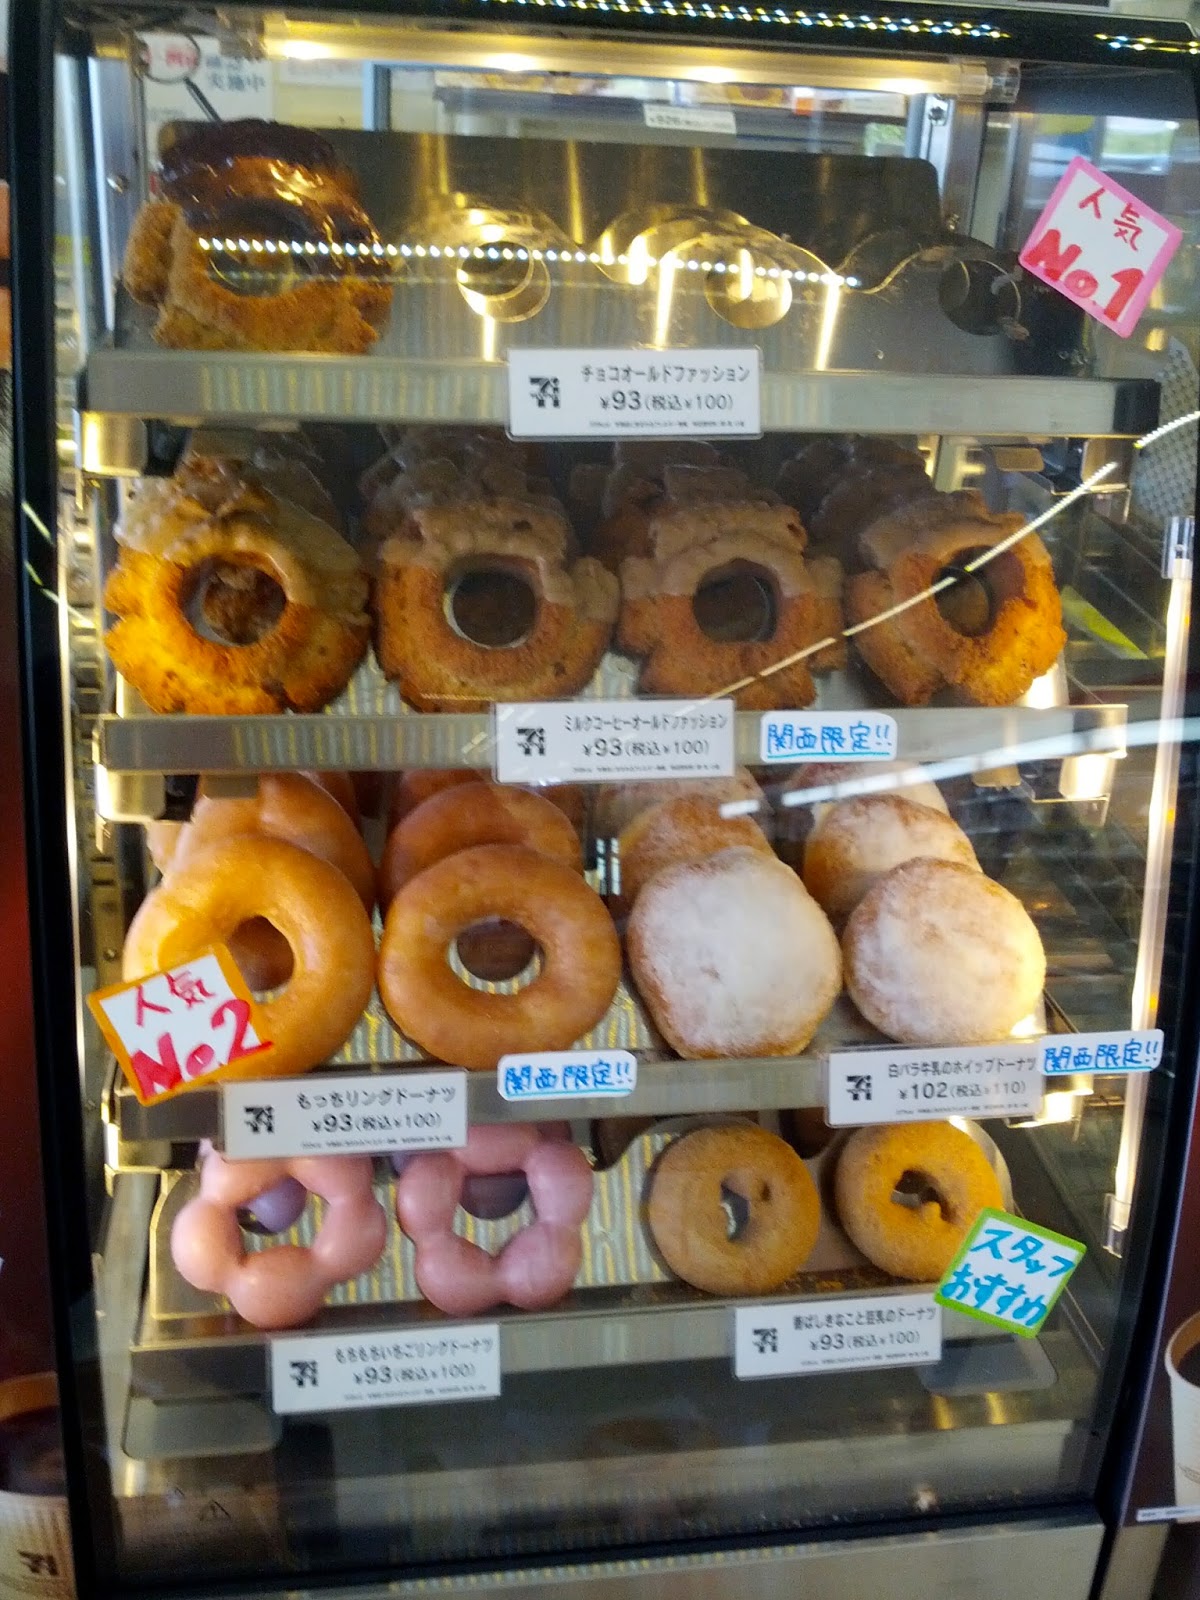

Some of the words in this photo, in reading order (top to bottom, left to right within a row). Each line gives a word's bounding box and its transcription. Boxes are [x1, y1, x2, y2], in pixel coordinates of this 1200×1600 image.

[1079, 187, 1142, 251] 人気
[1022, 228, 1144, 321] No.1
[580, 364, 750, 383] チョコオールドファッション
[565, 714, 727, 731] ミルクコーヒーオールドファッション
[767, 721, 892, 755] 関西限定!!
[136, 971, 216, 1026] 人気
[887, 1057, 1038, 1079] 白バラ牛乳のホイップドーナツ
[1044, 1038, 1159, 1071] 関西限定!!
[505, 1058, 633, 1095] 関西限定!!
[969, 1228, 1076, 1277] スタッフ
[941, 1263, 1047, 1326] おすすめ
